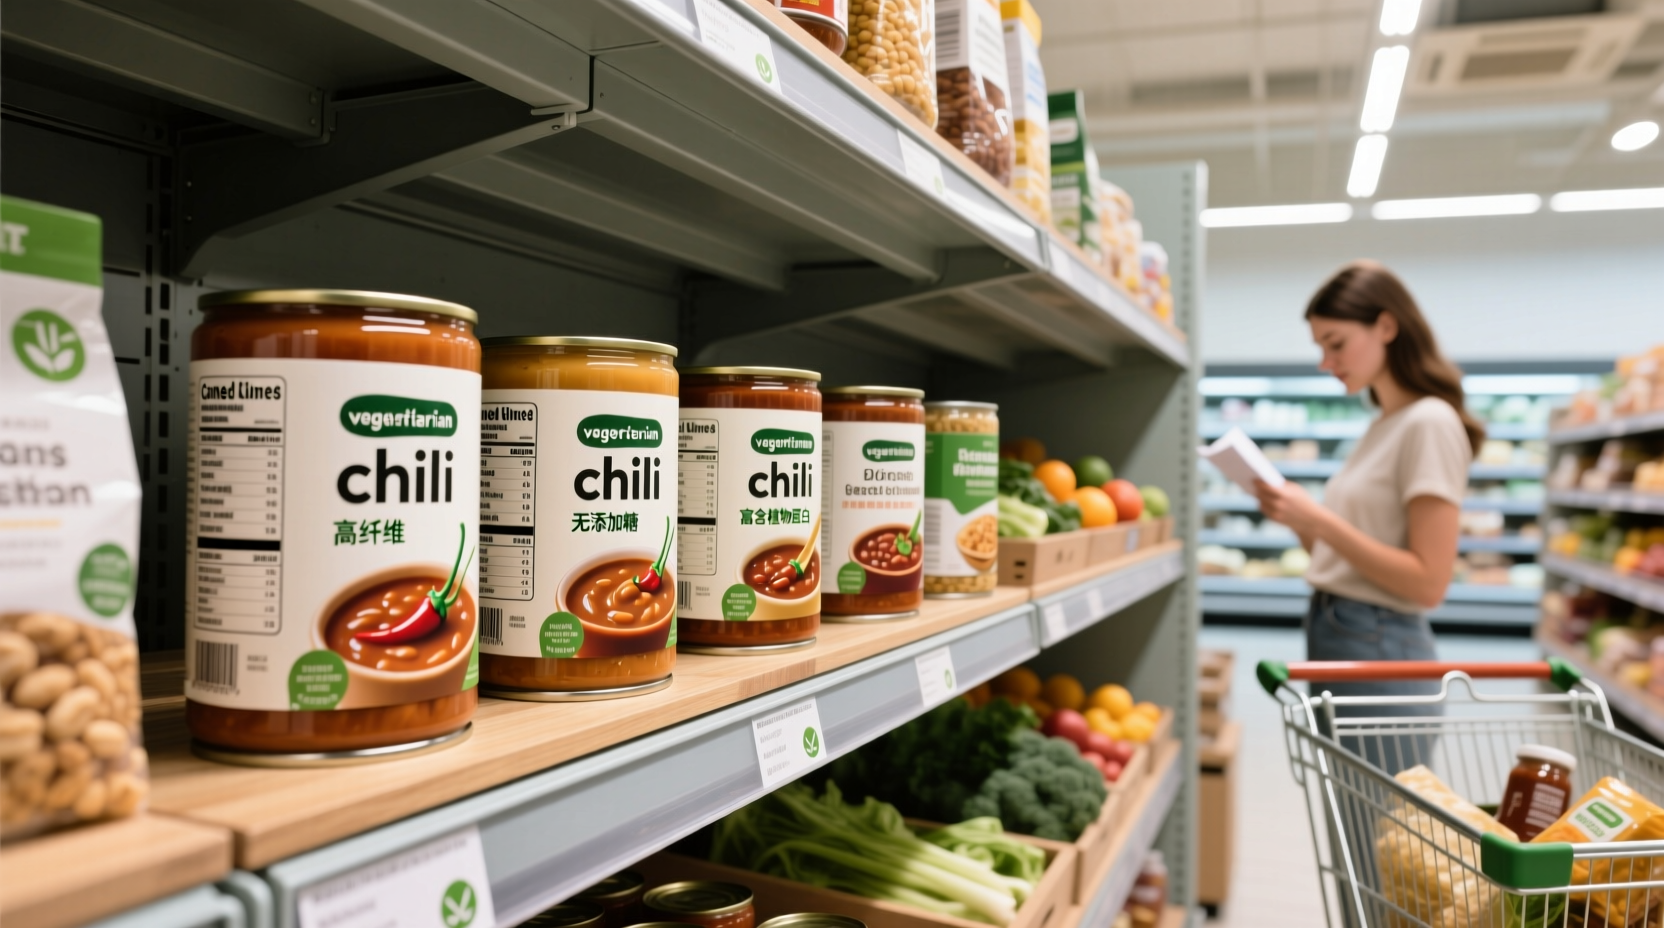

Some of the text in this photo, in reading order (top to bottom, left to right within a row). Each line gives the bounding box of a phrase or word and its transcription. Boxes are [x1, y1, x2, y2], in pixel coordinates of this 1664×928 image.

[337, 448, 454, 504] chili
[574, 456, 661, 501] chili
[748, 461, 813, 499] chili
[333, 518, 406, 547] 高纤维
[571, 511, 639, 533] 无添加糖
